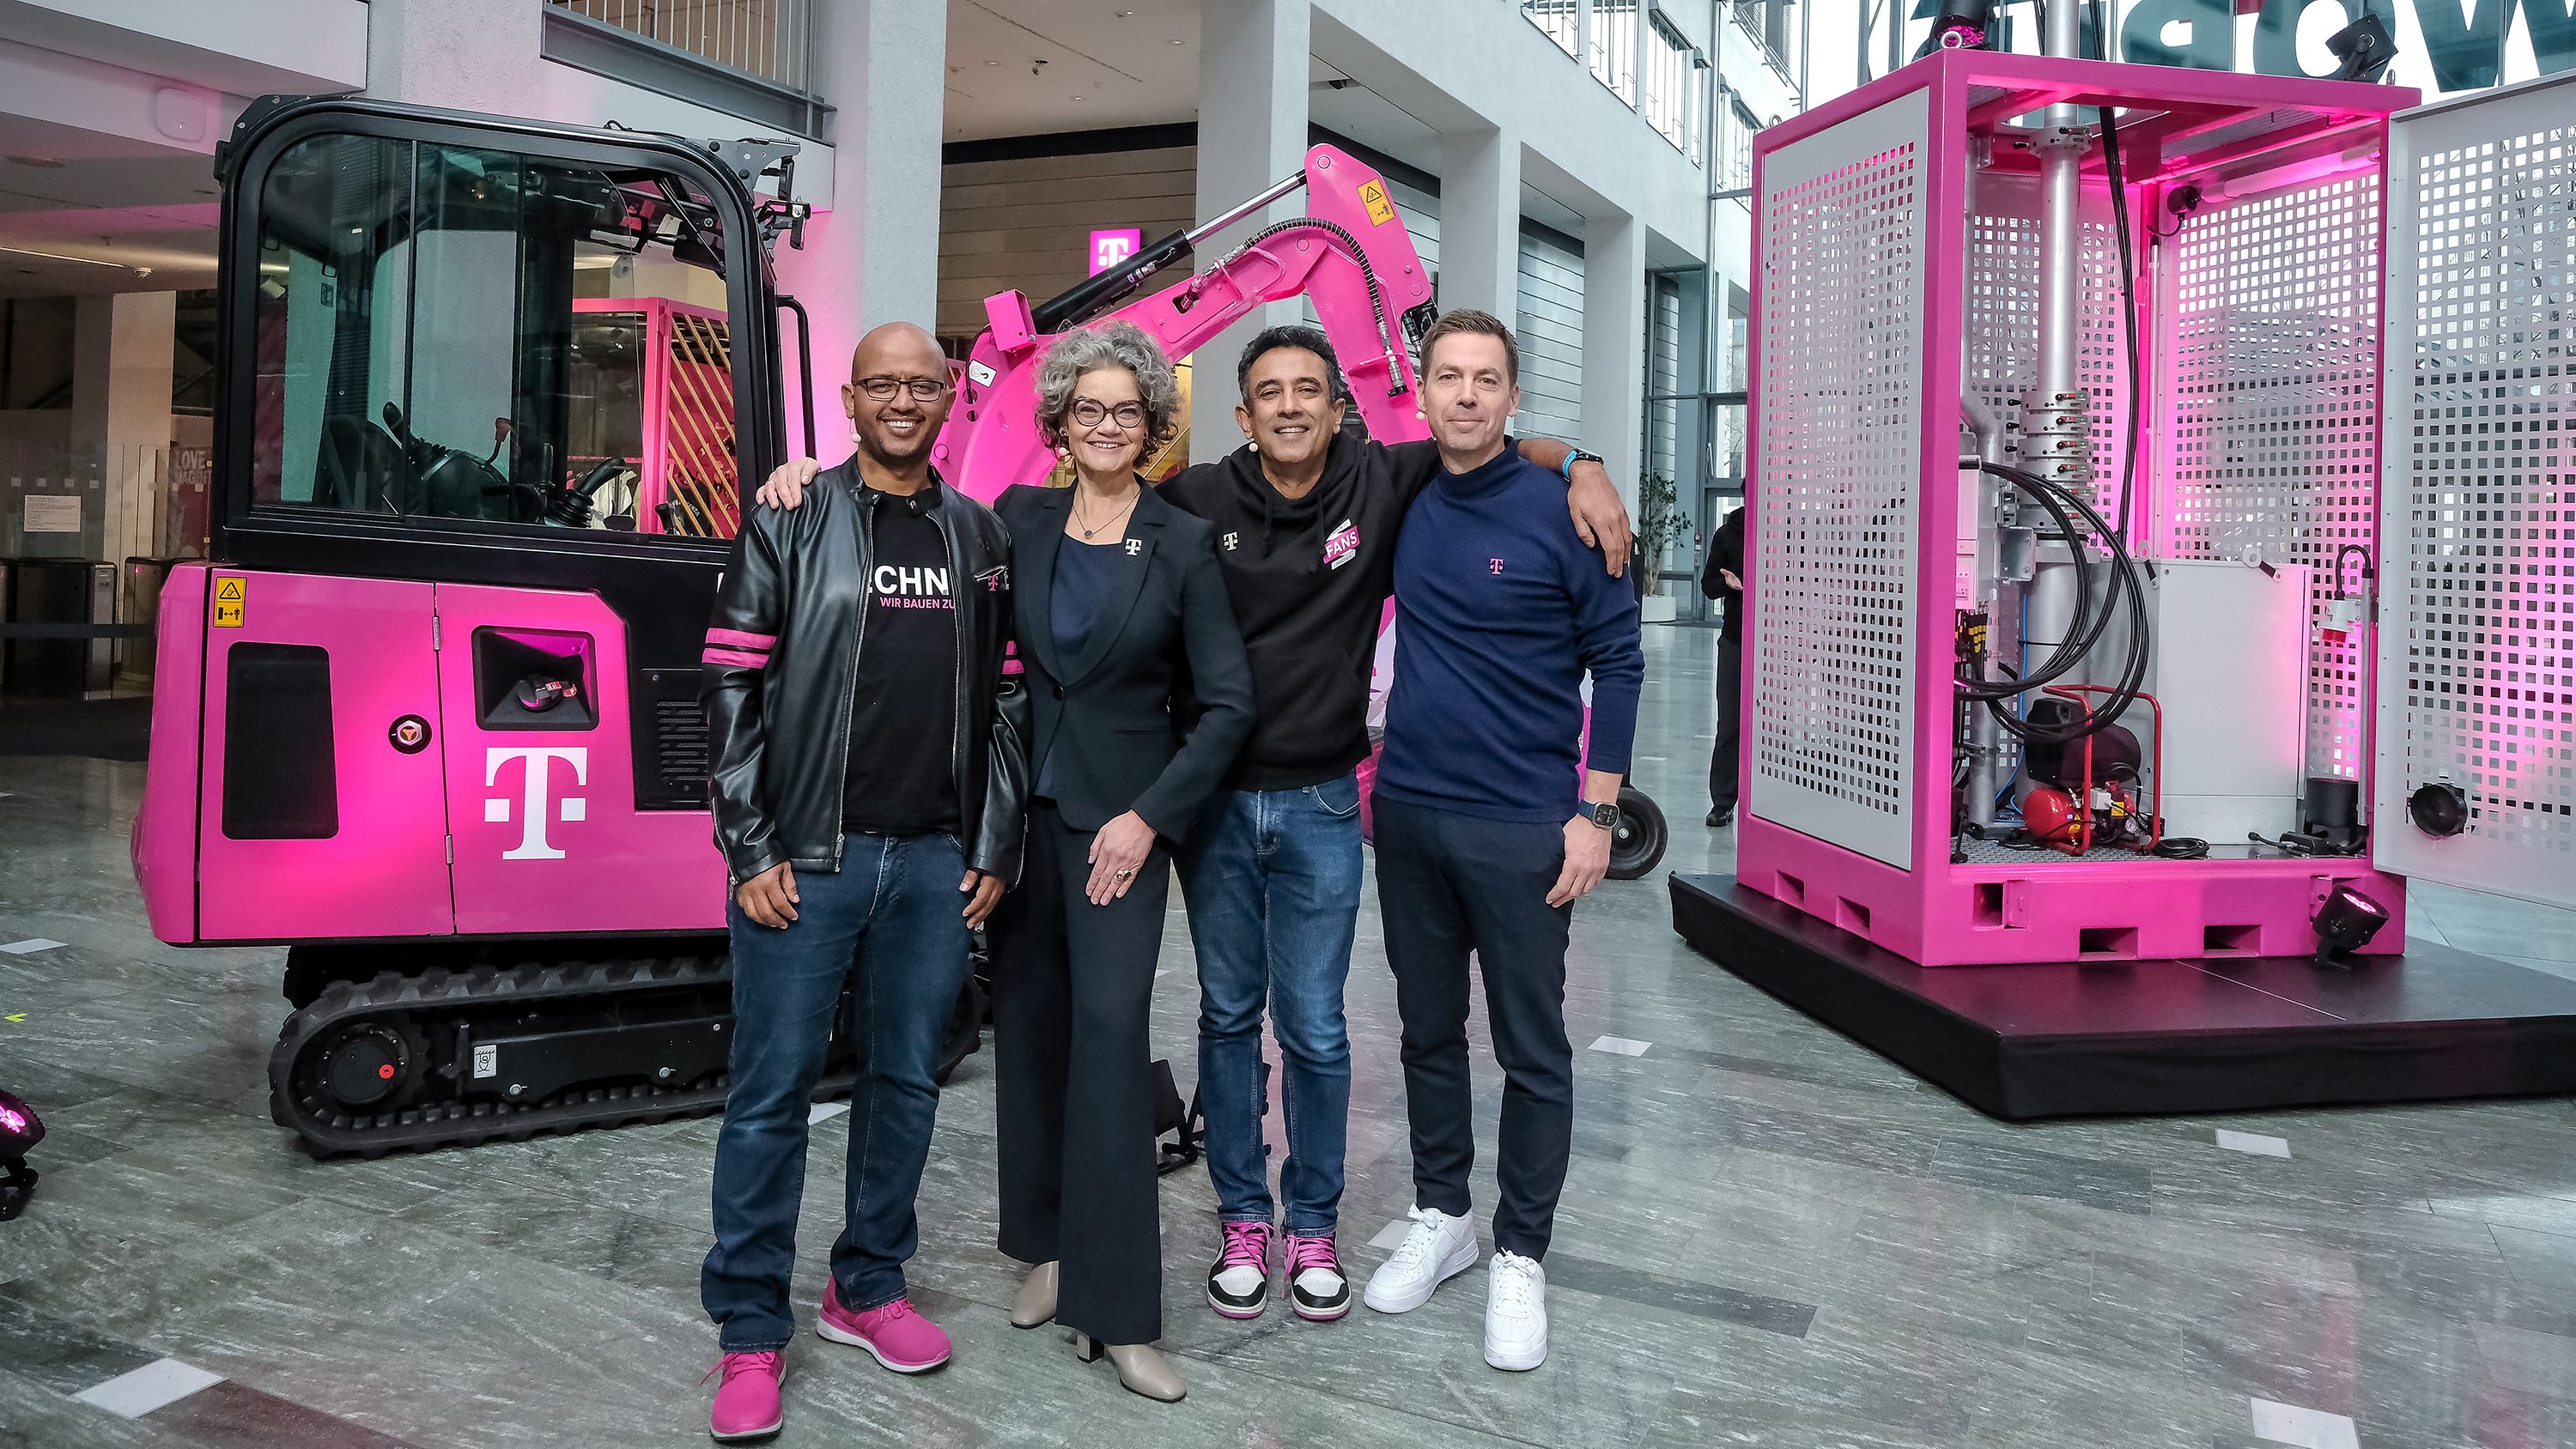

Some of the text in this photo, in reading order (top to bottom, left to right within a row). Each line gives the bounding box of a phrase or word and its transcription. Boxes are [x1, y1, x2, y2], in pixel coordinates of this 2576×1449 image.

[174, 450, 206, 470] LOVE
[174, 470, 213, 485] MAGENT
[1325, 530, 1358, 559] FANS
[869, 565, 950, 596] CHN
[879, 597, 956, 609] WIR BAUEN ZU
[484, 746, 588, 860] T
